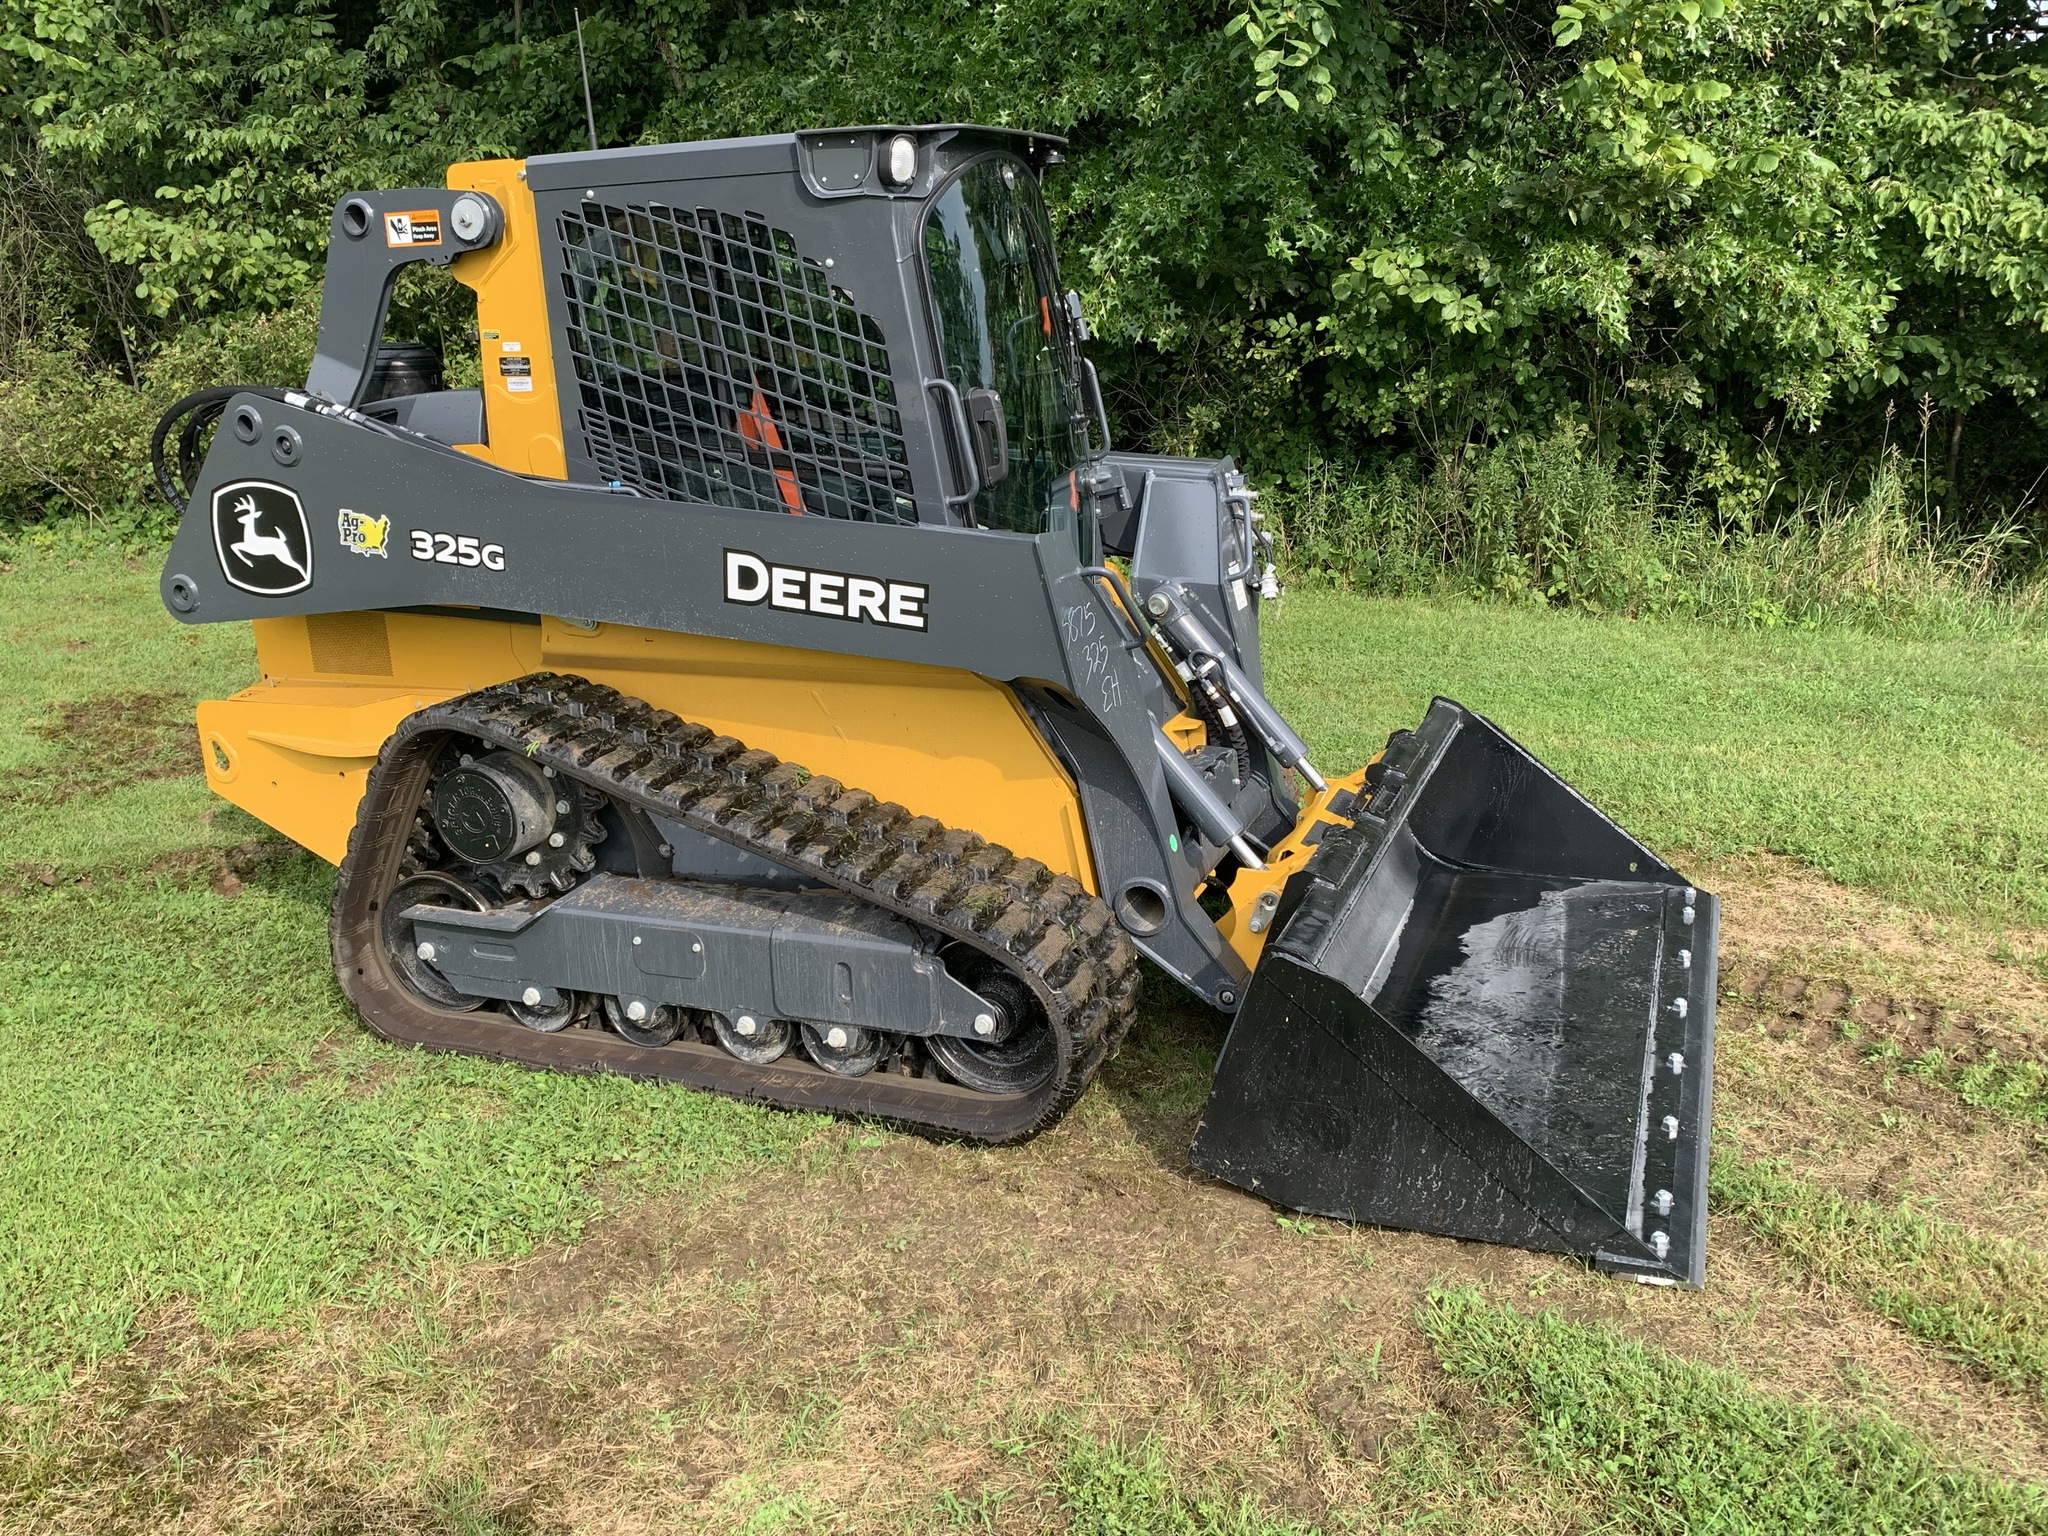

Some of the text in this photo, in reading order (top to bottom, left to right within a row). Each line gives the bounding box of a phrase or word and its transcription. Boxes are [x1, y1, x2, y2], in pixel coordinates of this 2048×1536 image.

[341, 513, 365, 532] Ag-
[342, 528, 366, 544] Pro
[411, 530, 505, 571] 325G
[726, 551, 926, 628] DEERE
[1081, 635, 1109, 688] 325
[1101, 669, 1123, 713] EH
